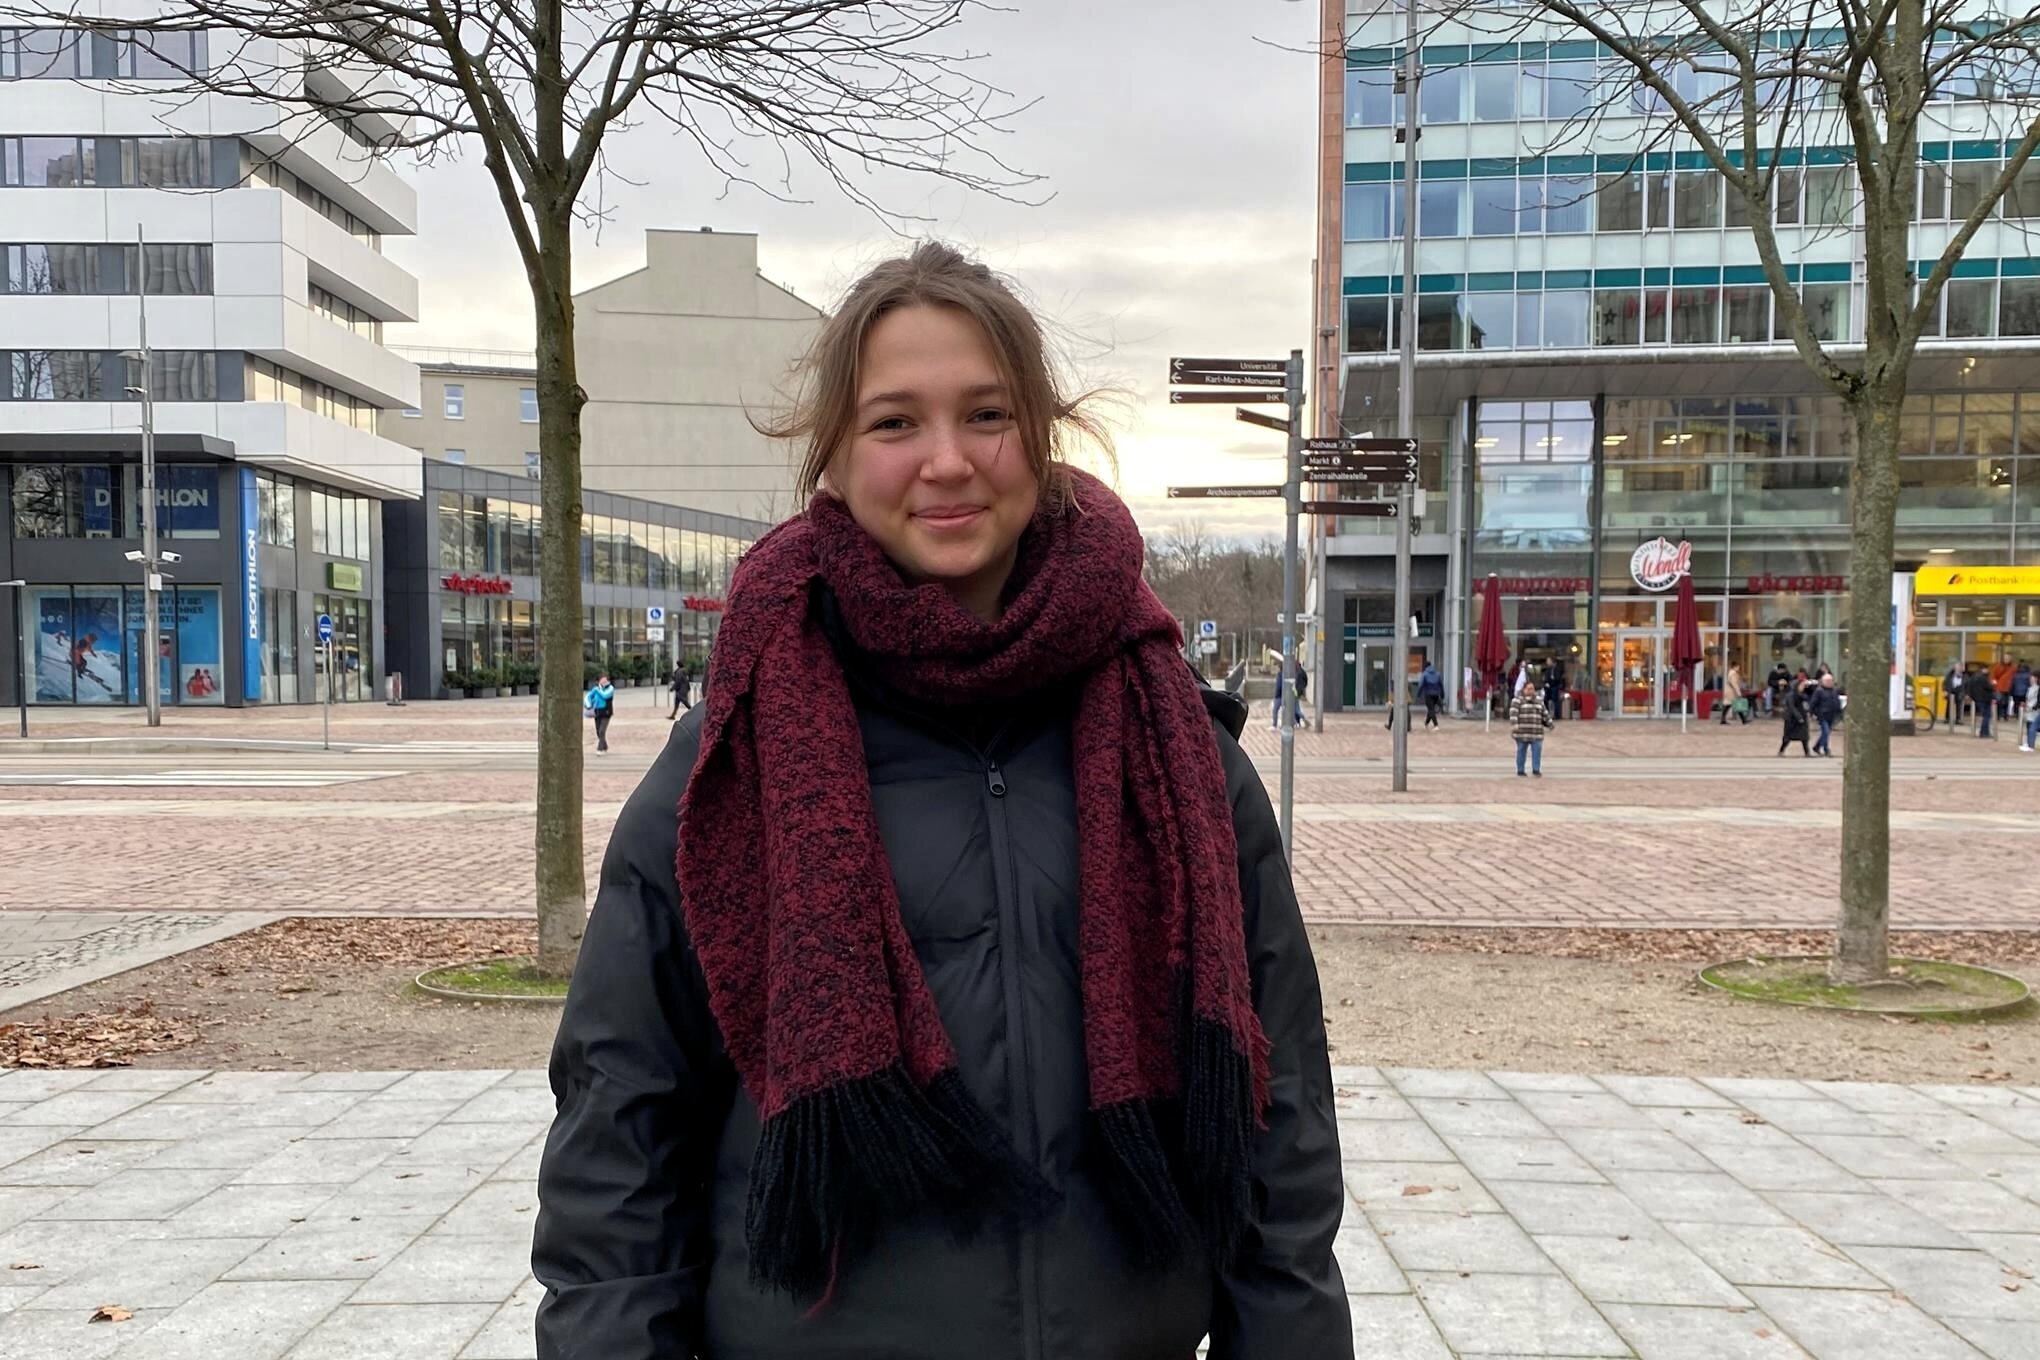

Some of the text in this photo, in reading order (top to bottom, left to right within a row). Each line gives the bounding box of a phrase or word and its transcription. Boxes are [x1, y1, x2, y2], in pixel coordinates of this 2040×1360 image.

[1240, 362, 1278, 370] Universität
[1205, 375, 1281, 385] Karl-Marx-Monument
[1309, 440, 1338, 448] Rathaus
[1309, 456, 1329, 464] Markt
[247, 528, 258, 639] DECATHLON
[1969, 576, 2018, 585] Postbank
